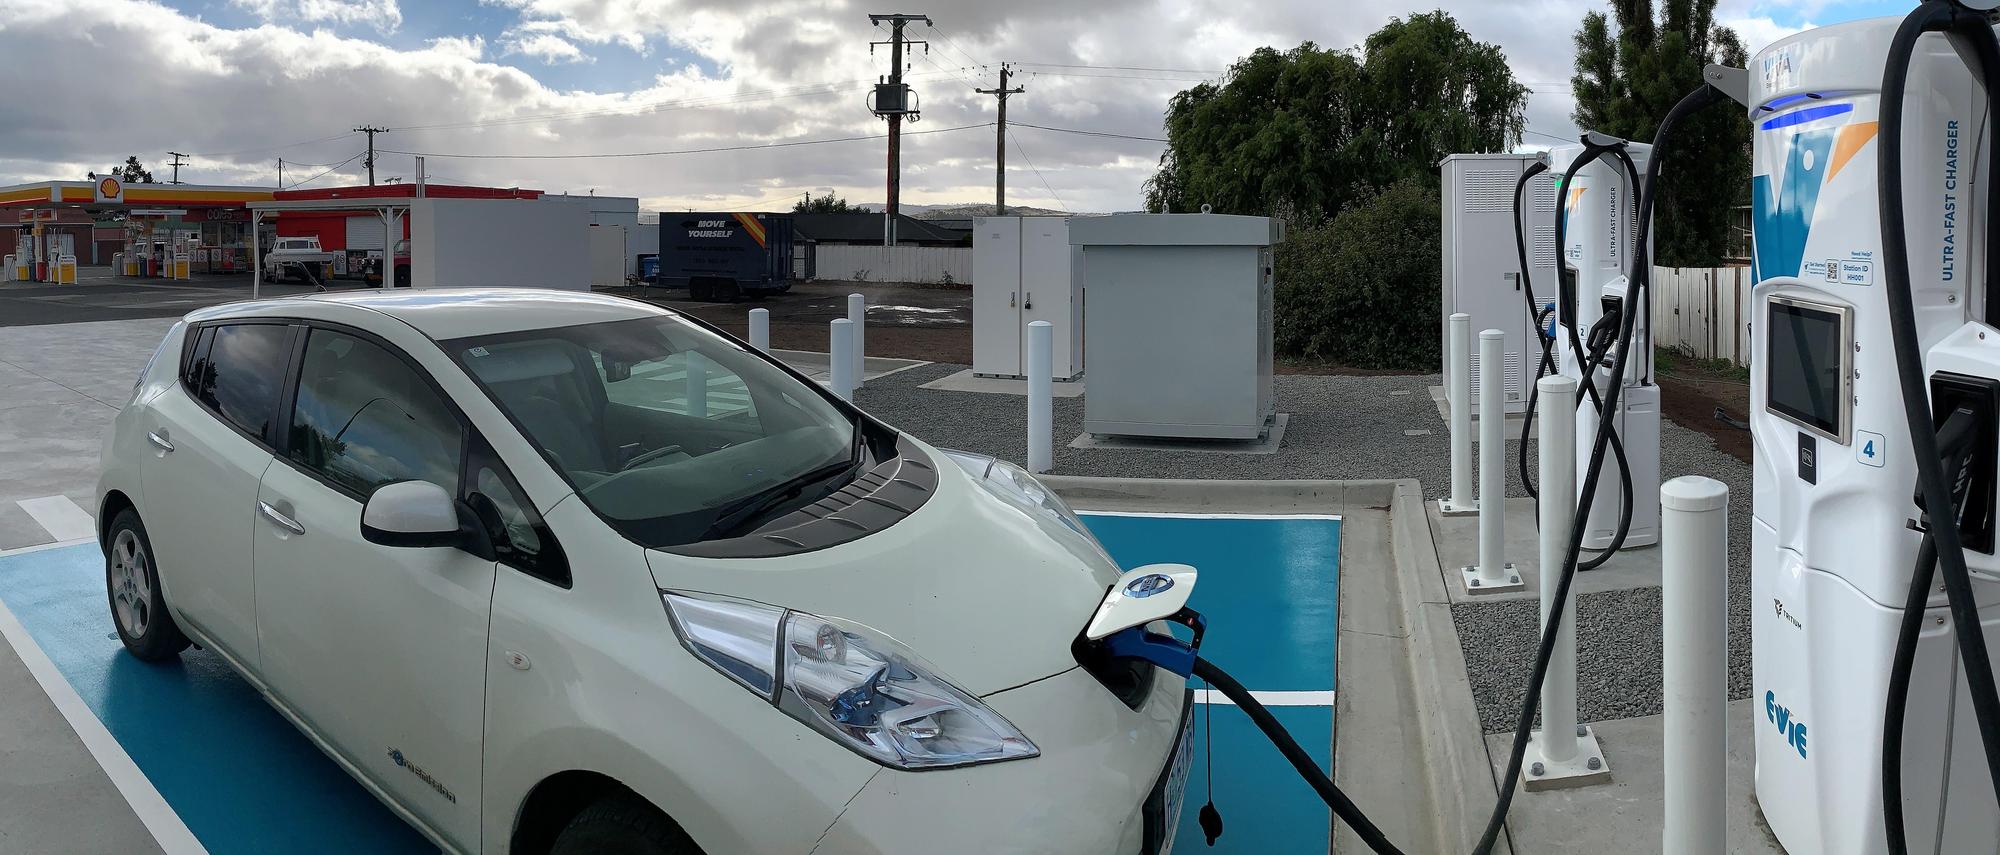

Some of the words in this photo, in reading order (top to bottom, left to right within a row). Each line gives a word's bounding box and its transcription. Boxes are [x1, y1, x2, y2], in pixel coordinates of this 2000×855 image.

[1945, 120, 1959, 190] CHARGER
[697, 220, 726, 228] MOVE
[688, 230, 733, 238] YOURSELF
[1942, 194, 1956, 281] ULTRA-FAST
[1843, 264, 1861, 272] Station
[1580, 328, 1585, 336] 2
[1863, 440, 1875, 458] 4
